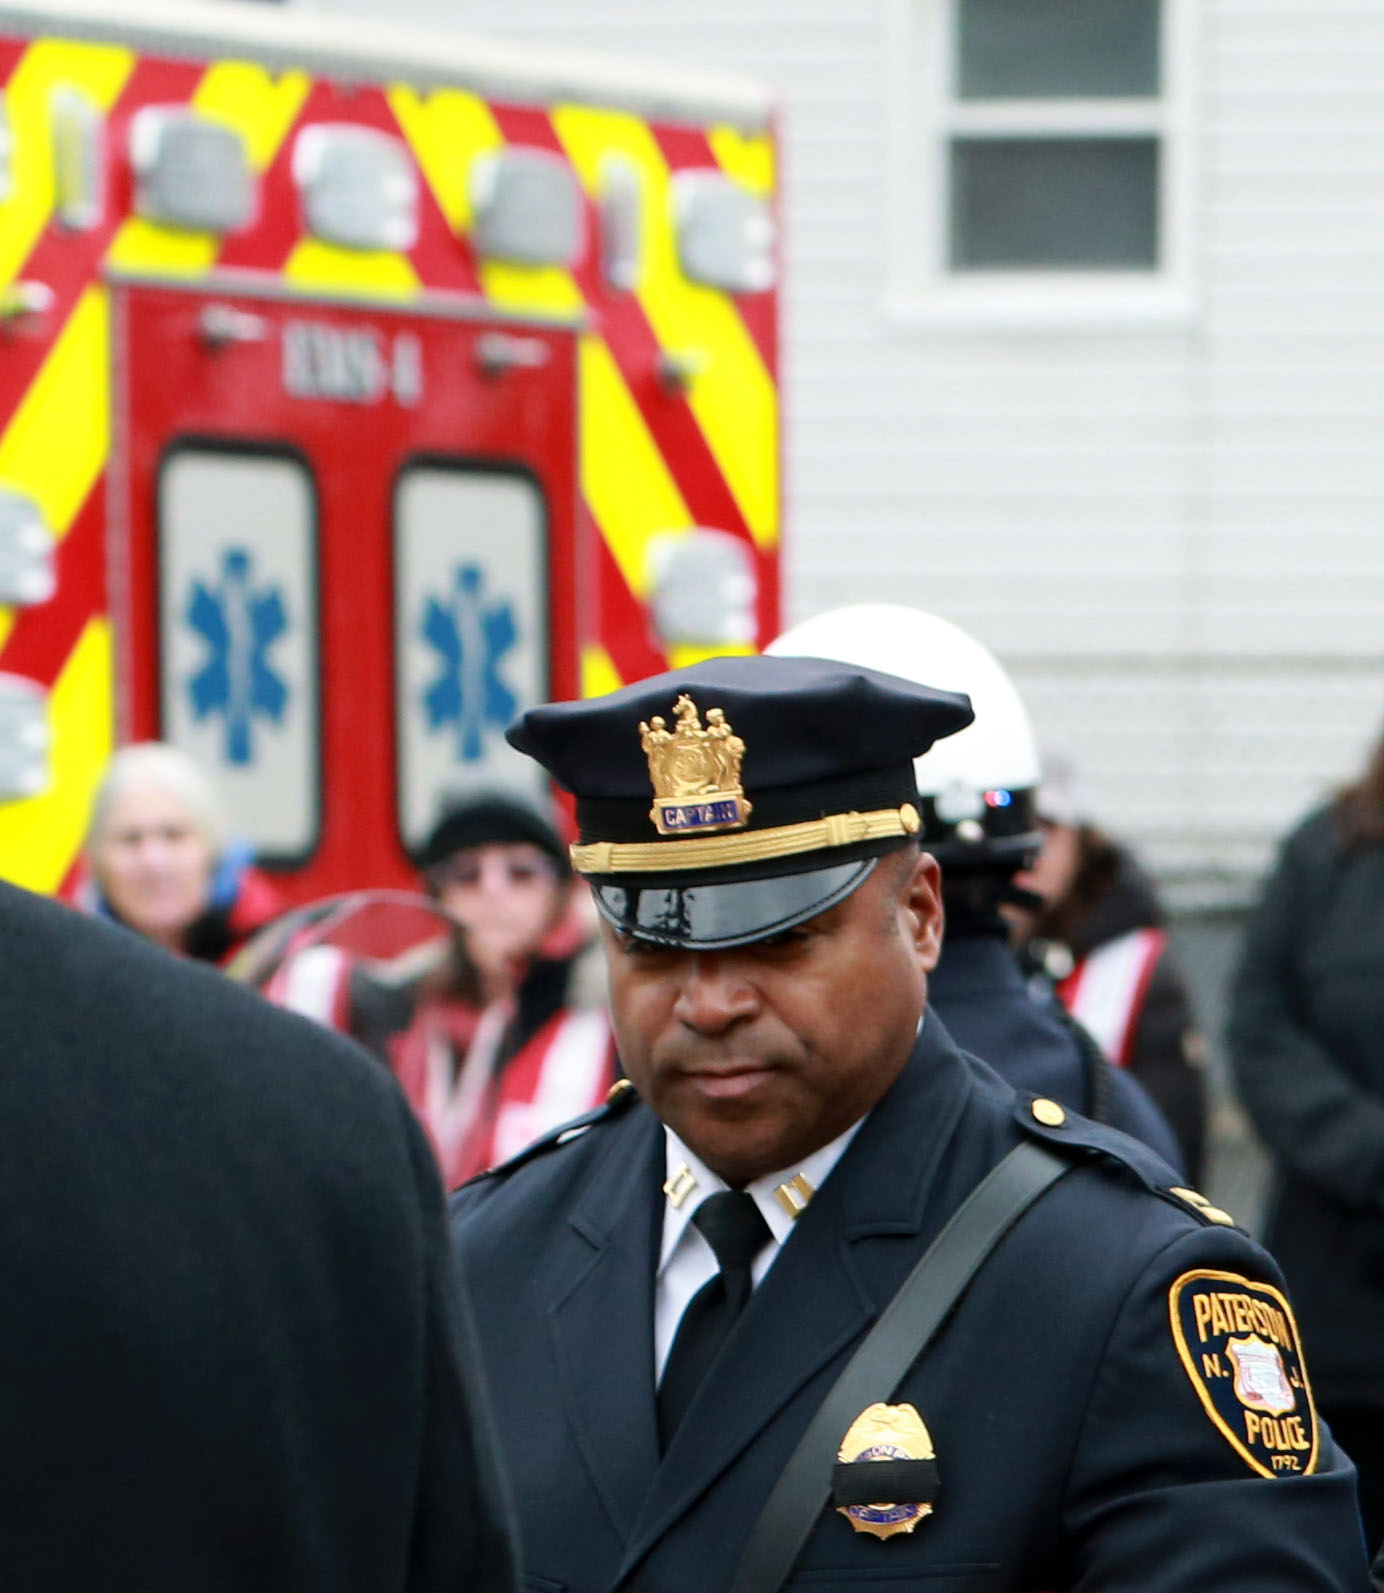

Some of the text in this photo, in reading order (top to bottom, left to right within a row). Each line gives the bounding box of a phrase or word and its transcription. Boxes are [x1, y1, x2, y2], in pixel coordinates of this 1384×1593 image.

[664, 803, 733, 826] CAPTAIN
[1193, 1292, 1292, 1353] PATERSON
[1202, 1353, 1229, 1378] N.
[1244, 1410, 1310, 1451] POLICE
[1271, 1455, 1302, 1471] 1792
